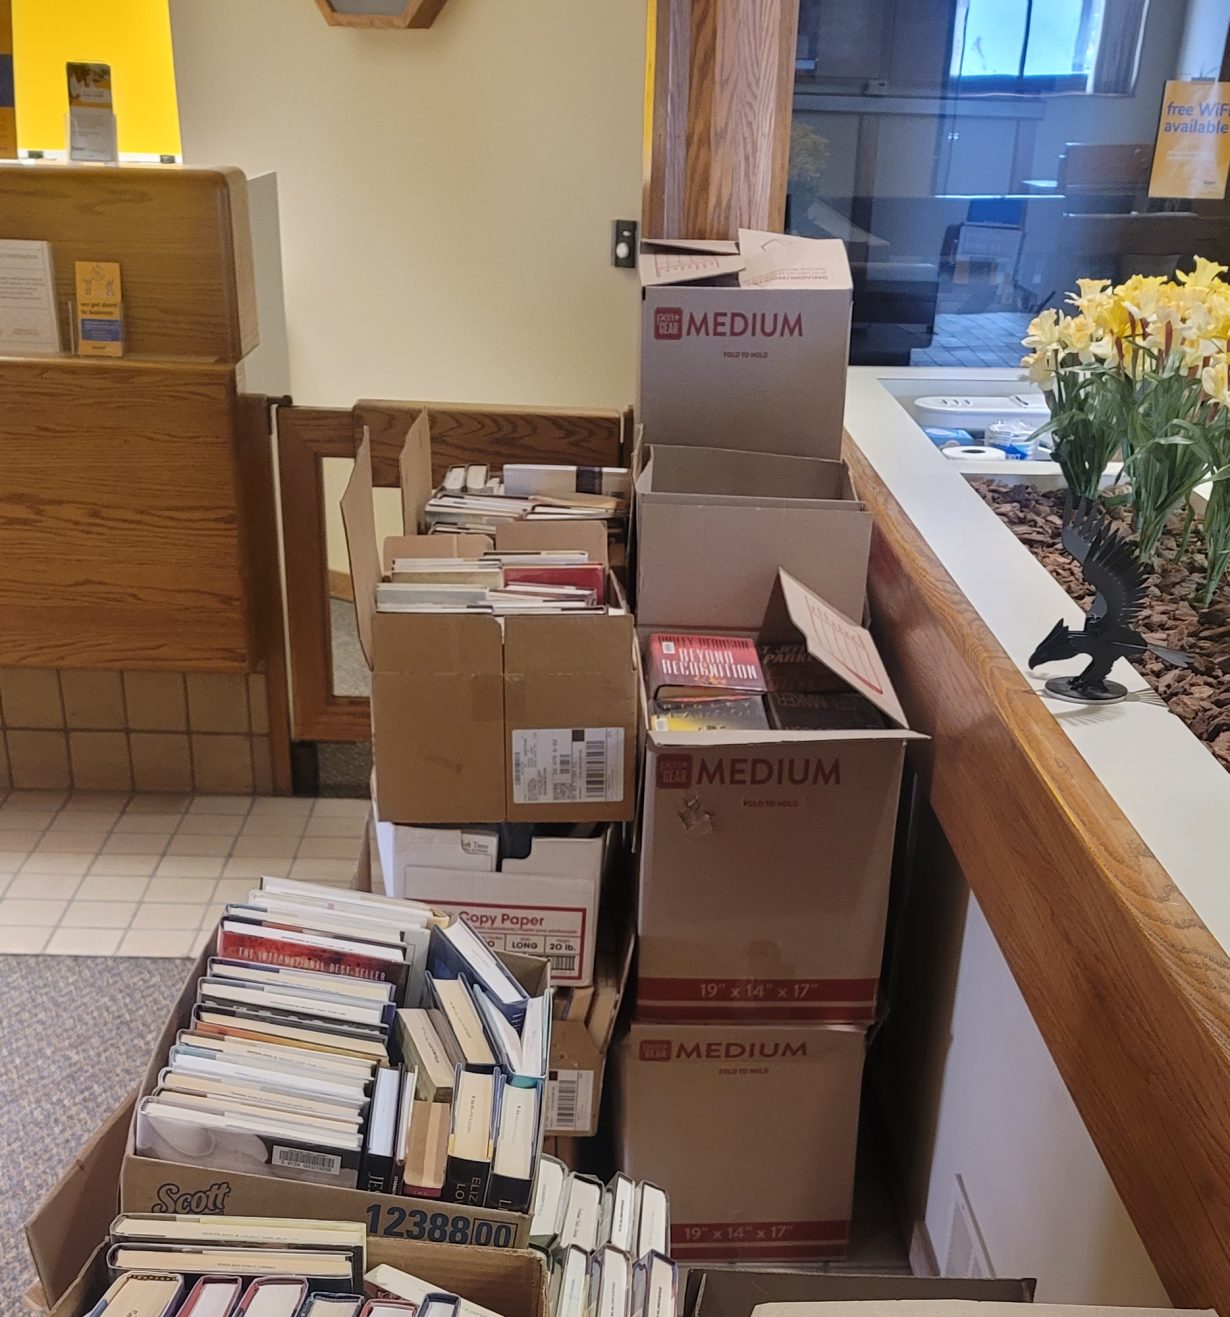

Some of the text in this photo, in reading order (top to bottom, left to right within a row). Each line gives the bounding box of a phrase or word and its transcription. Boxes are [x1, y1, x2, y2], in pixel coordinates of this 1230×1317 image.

[1167, 101, 1194, 116] free
[1164, 119, 1229, 134] available
[658, 321, 680, 335] GEAR
[686, 311, 804, 338] MEDIUM
[723, 351, 740, 359] FOLD
[741, 351, 750, 359] TO
[678, 648, 734, 664] BEYOND
[661, 659, 758, 680] RECOGNITION
[695, 757, 841, 786] MEDIUM
[743, 800, 799, 808] FOLD TO HOLD
[458, 911, 497, 930] Copy
[501, 913, 545, 927] Paper
[511, 941, 577, 952] LONG 20 lb.
[238, 947, 254, 959] THE
[258, 951, 326, 972] INTERNATIONAL
[700, 982, 819, 999] 19" x 14" x 17"
[675, 1041, 809, 1059] MEDIUM
[152, 1181, 231, 1214] Scott
[455, 1183, 465, 1204] LO
[684, 1225, 794, 1240] 19" x 14" x 17"
